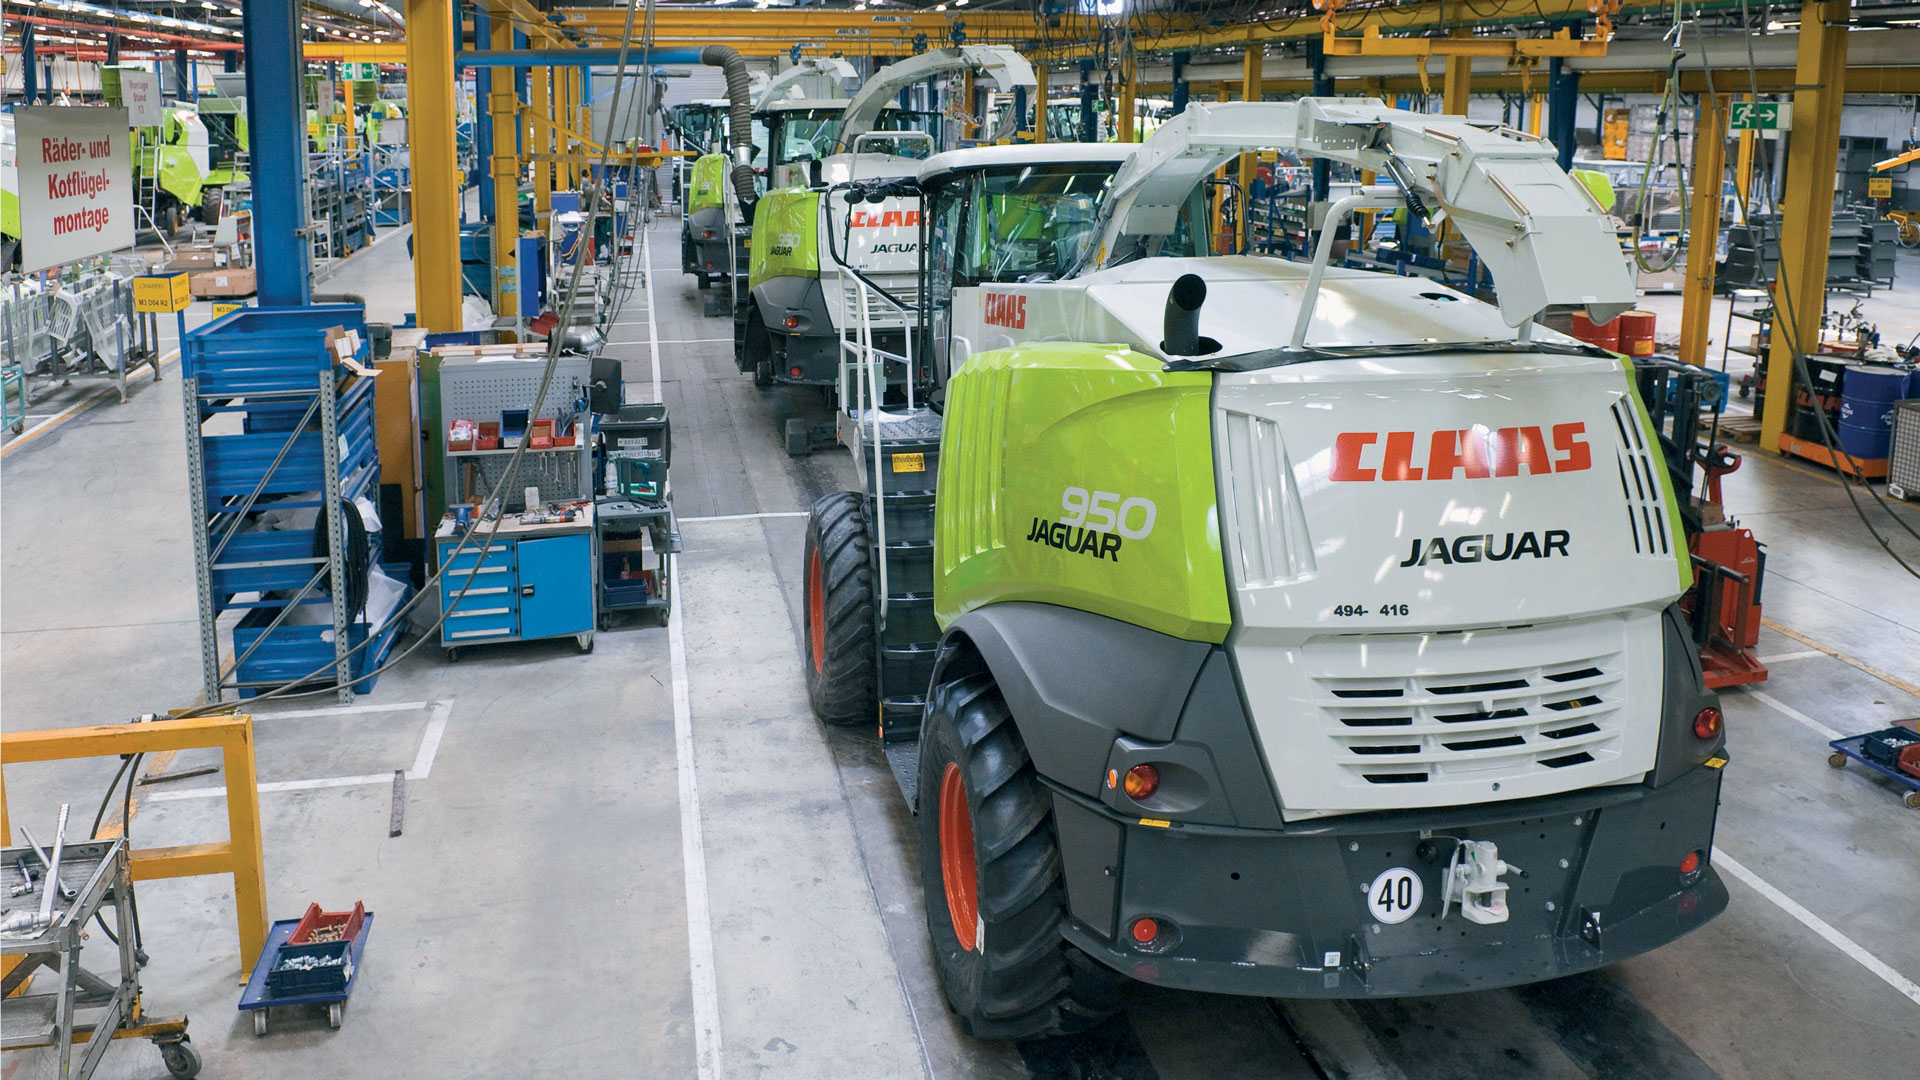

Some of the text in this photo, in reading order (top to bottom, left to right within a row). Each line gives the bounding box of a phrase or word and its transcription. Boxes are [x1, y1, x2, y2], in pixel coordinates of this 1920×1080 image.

[42, 135, 111, 163] Räder- und
[48, 168, 110, 200] Kotflügel-
[53, 206, 109, 235] montage
[850, 211, 929, 228] CLAA
[770, 245, 793, 256] JAGUAR
[984, 293, 1027, 330] CLAAS
[1328, 421, 1592, 482] CLAAS
[1059, 486, 1157, 540] 950
[1026, 517, 1122, 562] JAGUAR
[1400, 529, 1570, 567] JAGUAR
[1333, 604, 1409, 617] 494- 416
[1377, 876, 1412, 913] 40
